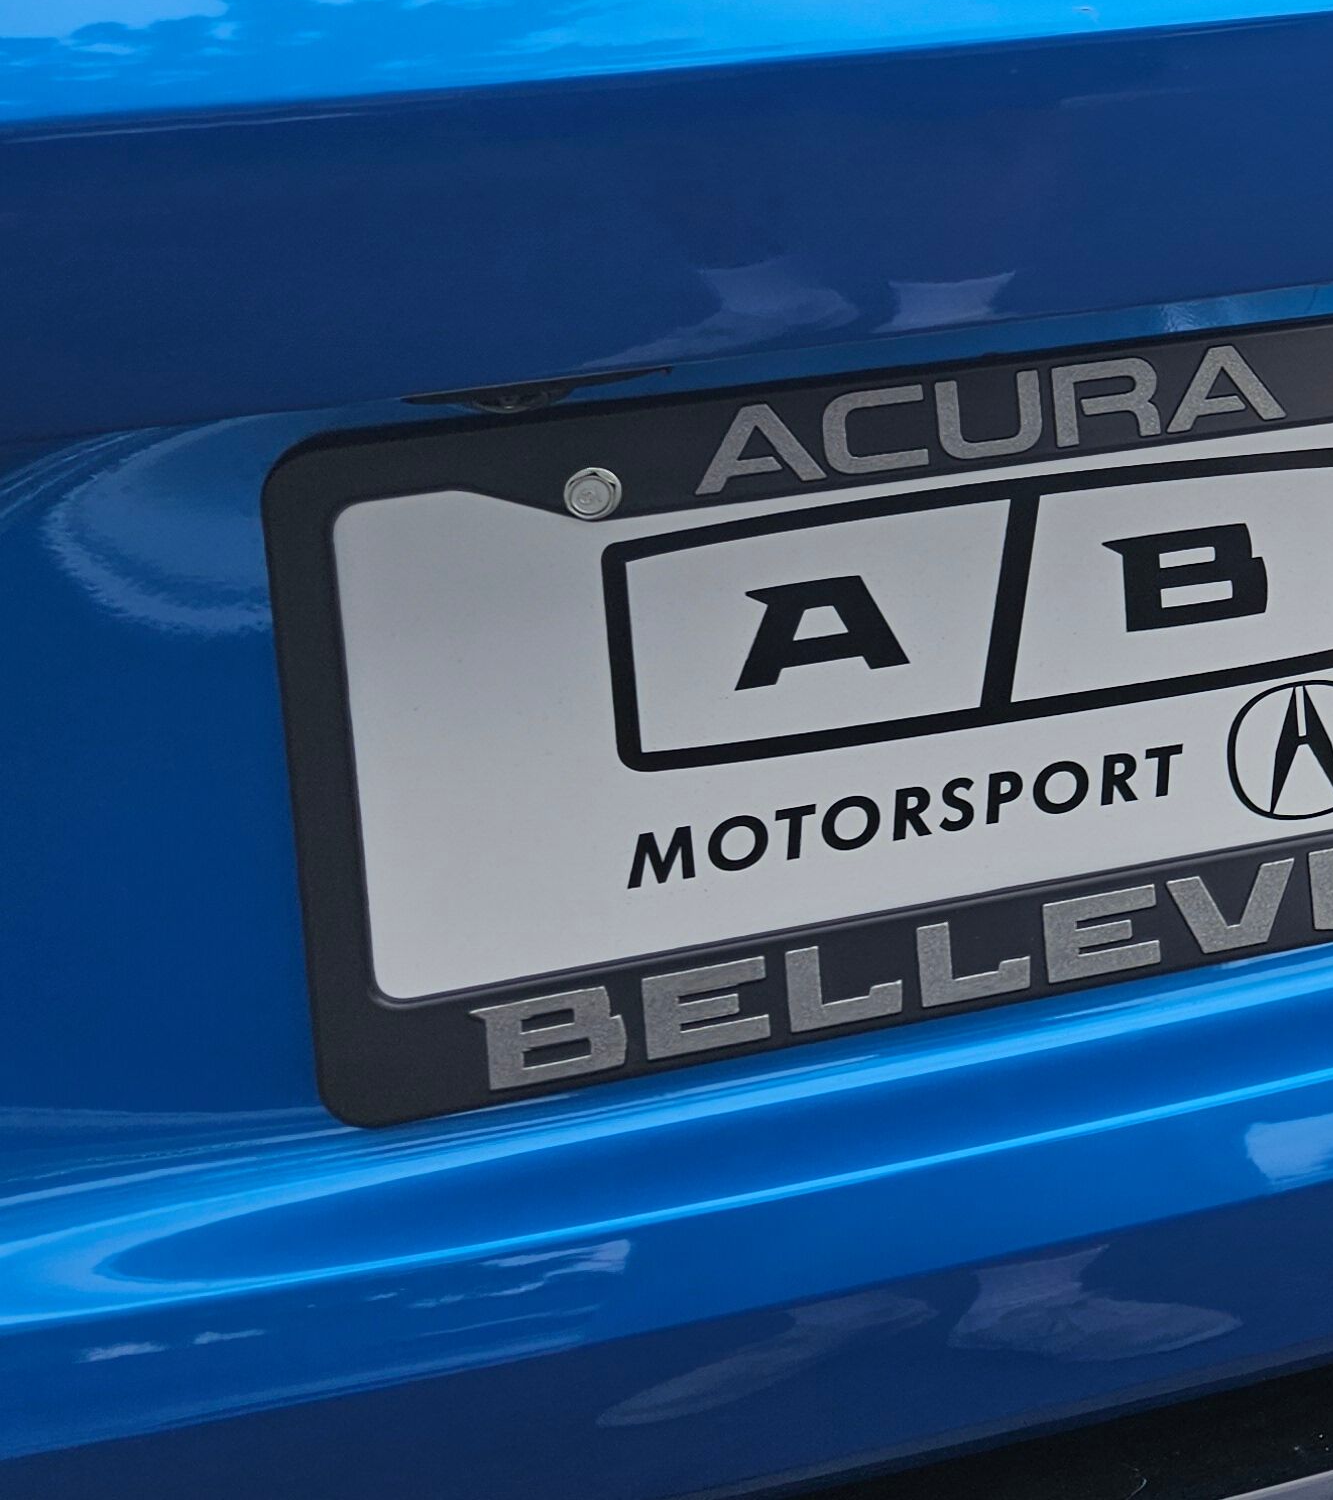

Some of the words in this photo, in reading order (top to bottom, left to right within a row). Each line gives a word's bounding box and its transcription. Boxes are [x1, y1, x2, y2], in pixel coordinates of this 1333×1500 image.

[695, 345, 1287, 495] ACURA
[734, 574, 911, 691] A
[1101, 522, 1268, 633] B
[626, 744, 1184, 889] MOTORSPORT
